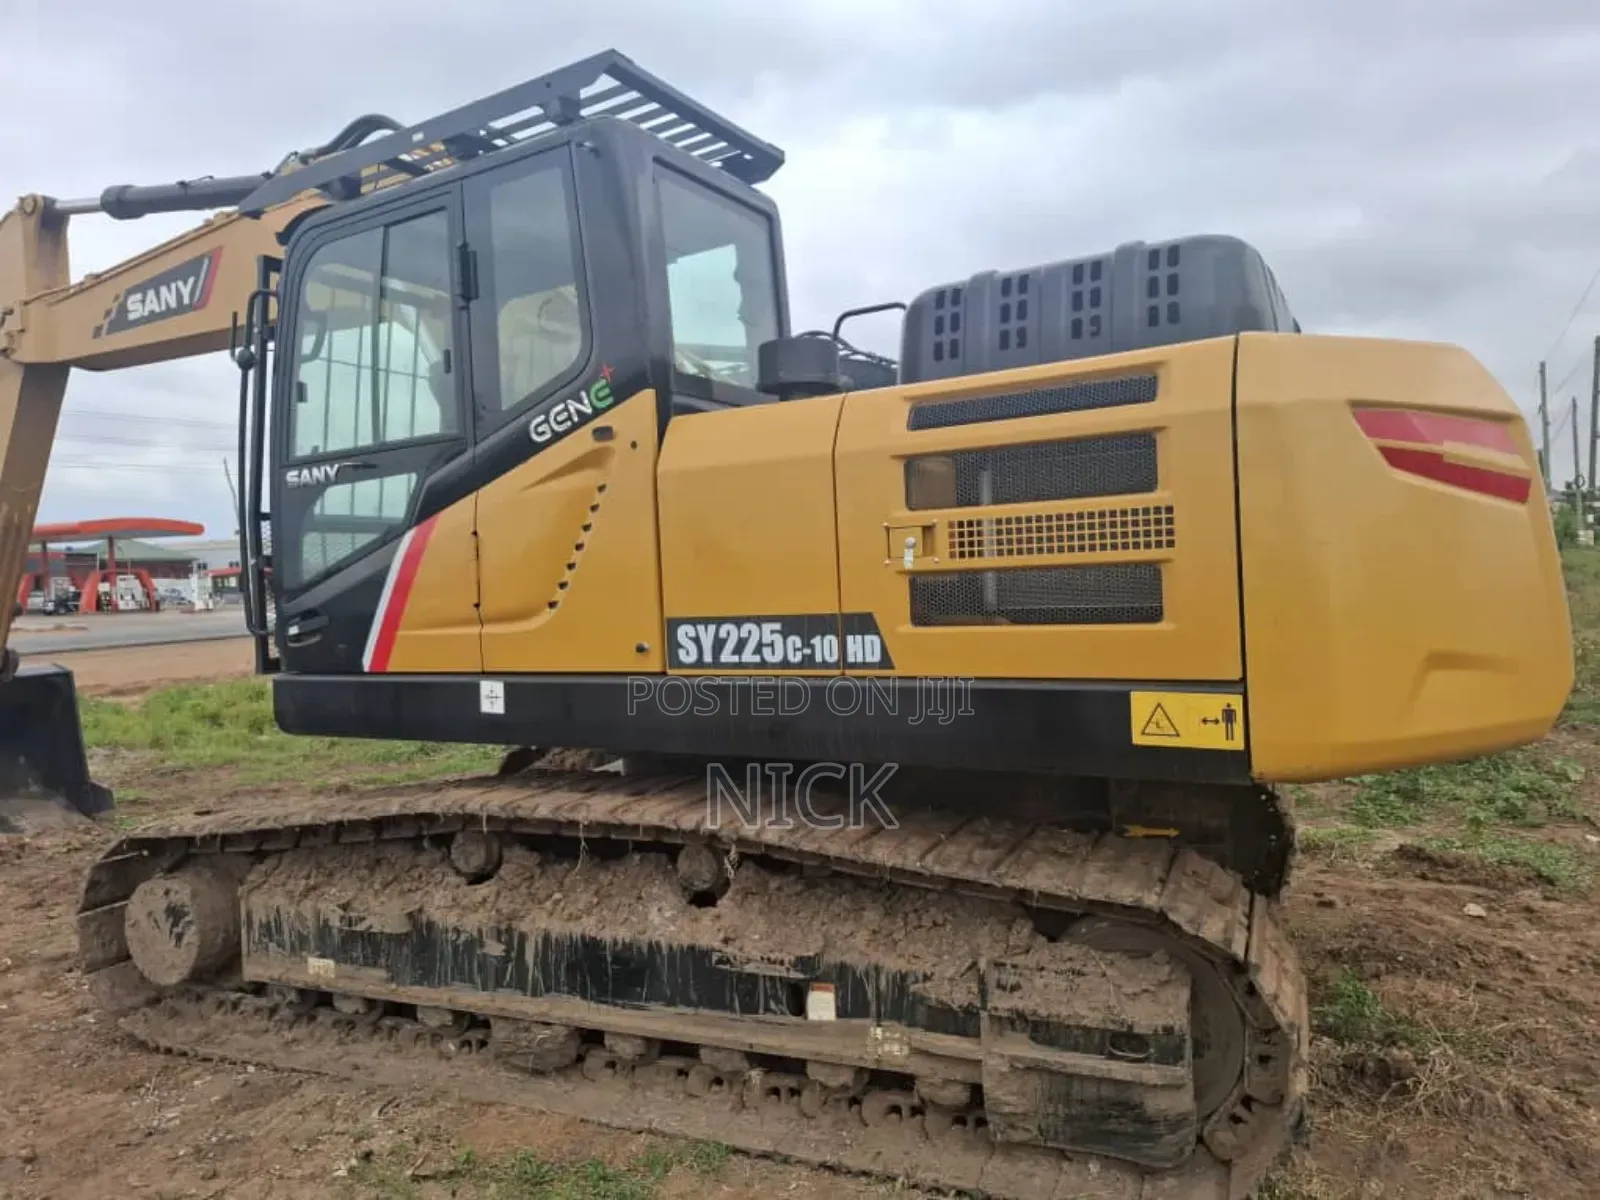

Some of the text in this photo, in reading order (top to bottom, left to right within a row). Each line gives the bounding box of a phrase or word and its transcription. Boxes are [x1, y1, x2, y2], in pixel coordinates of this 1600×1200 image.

[126, 276, 195, 320] SANY
[286, 463, 340, 488] SANY
[846, 634, 882, 662] HD
